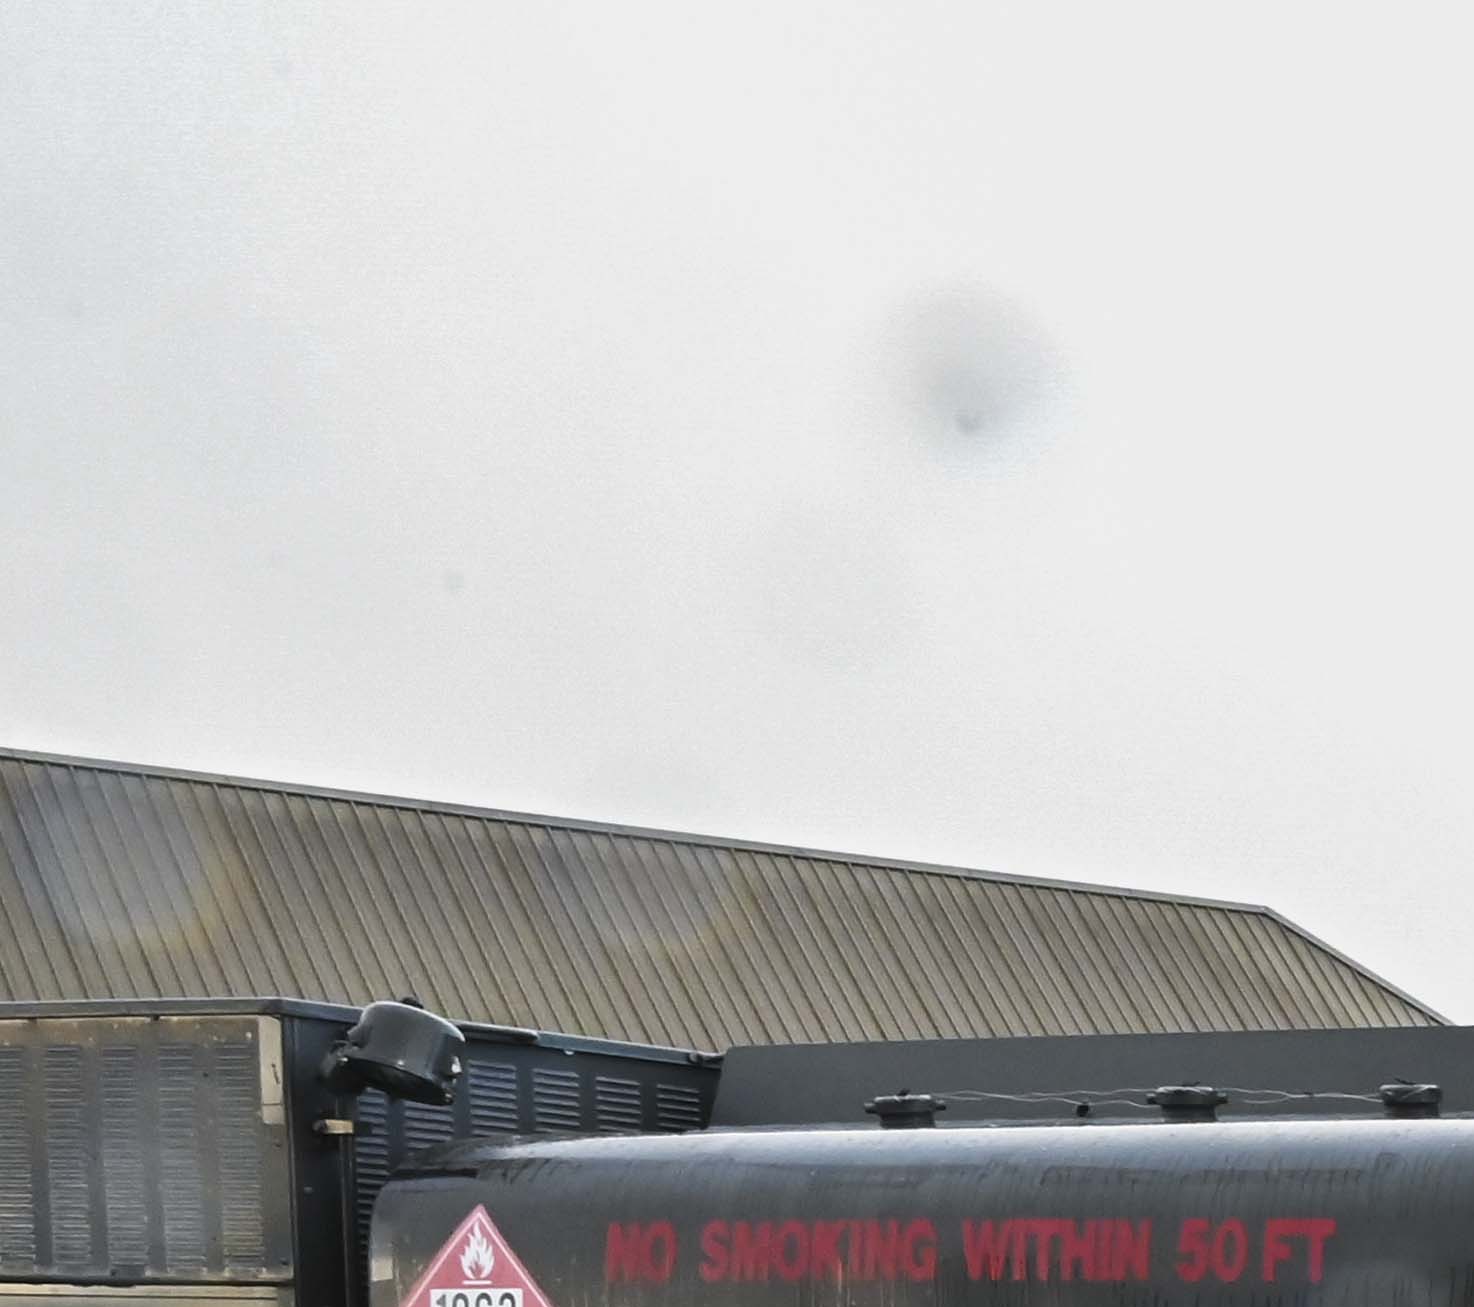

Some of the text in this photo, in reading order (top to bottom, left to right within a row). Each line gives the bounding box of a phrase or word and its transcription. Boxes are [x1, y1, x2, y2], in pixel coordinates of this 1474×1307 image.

[607, 1218, 1337, 1283] NO SMOKING WITHIN 50 FT
